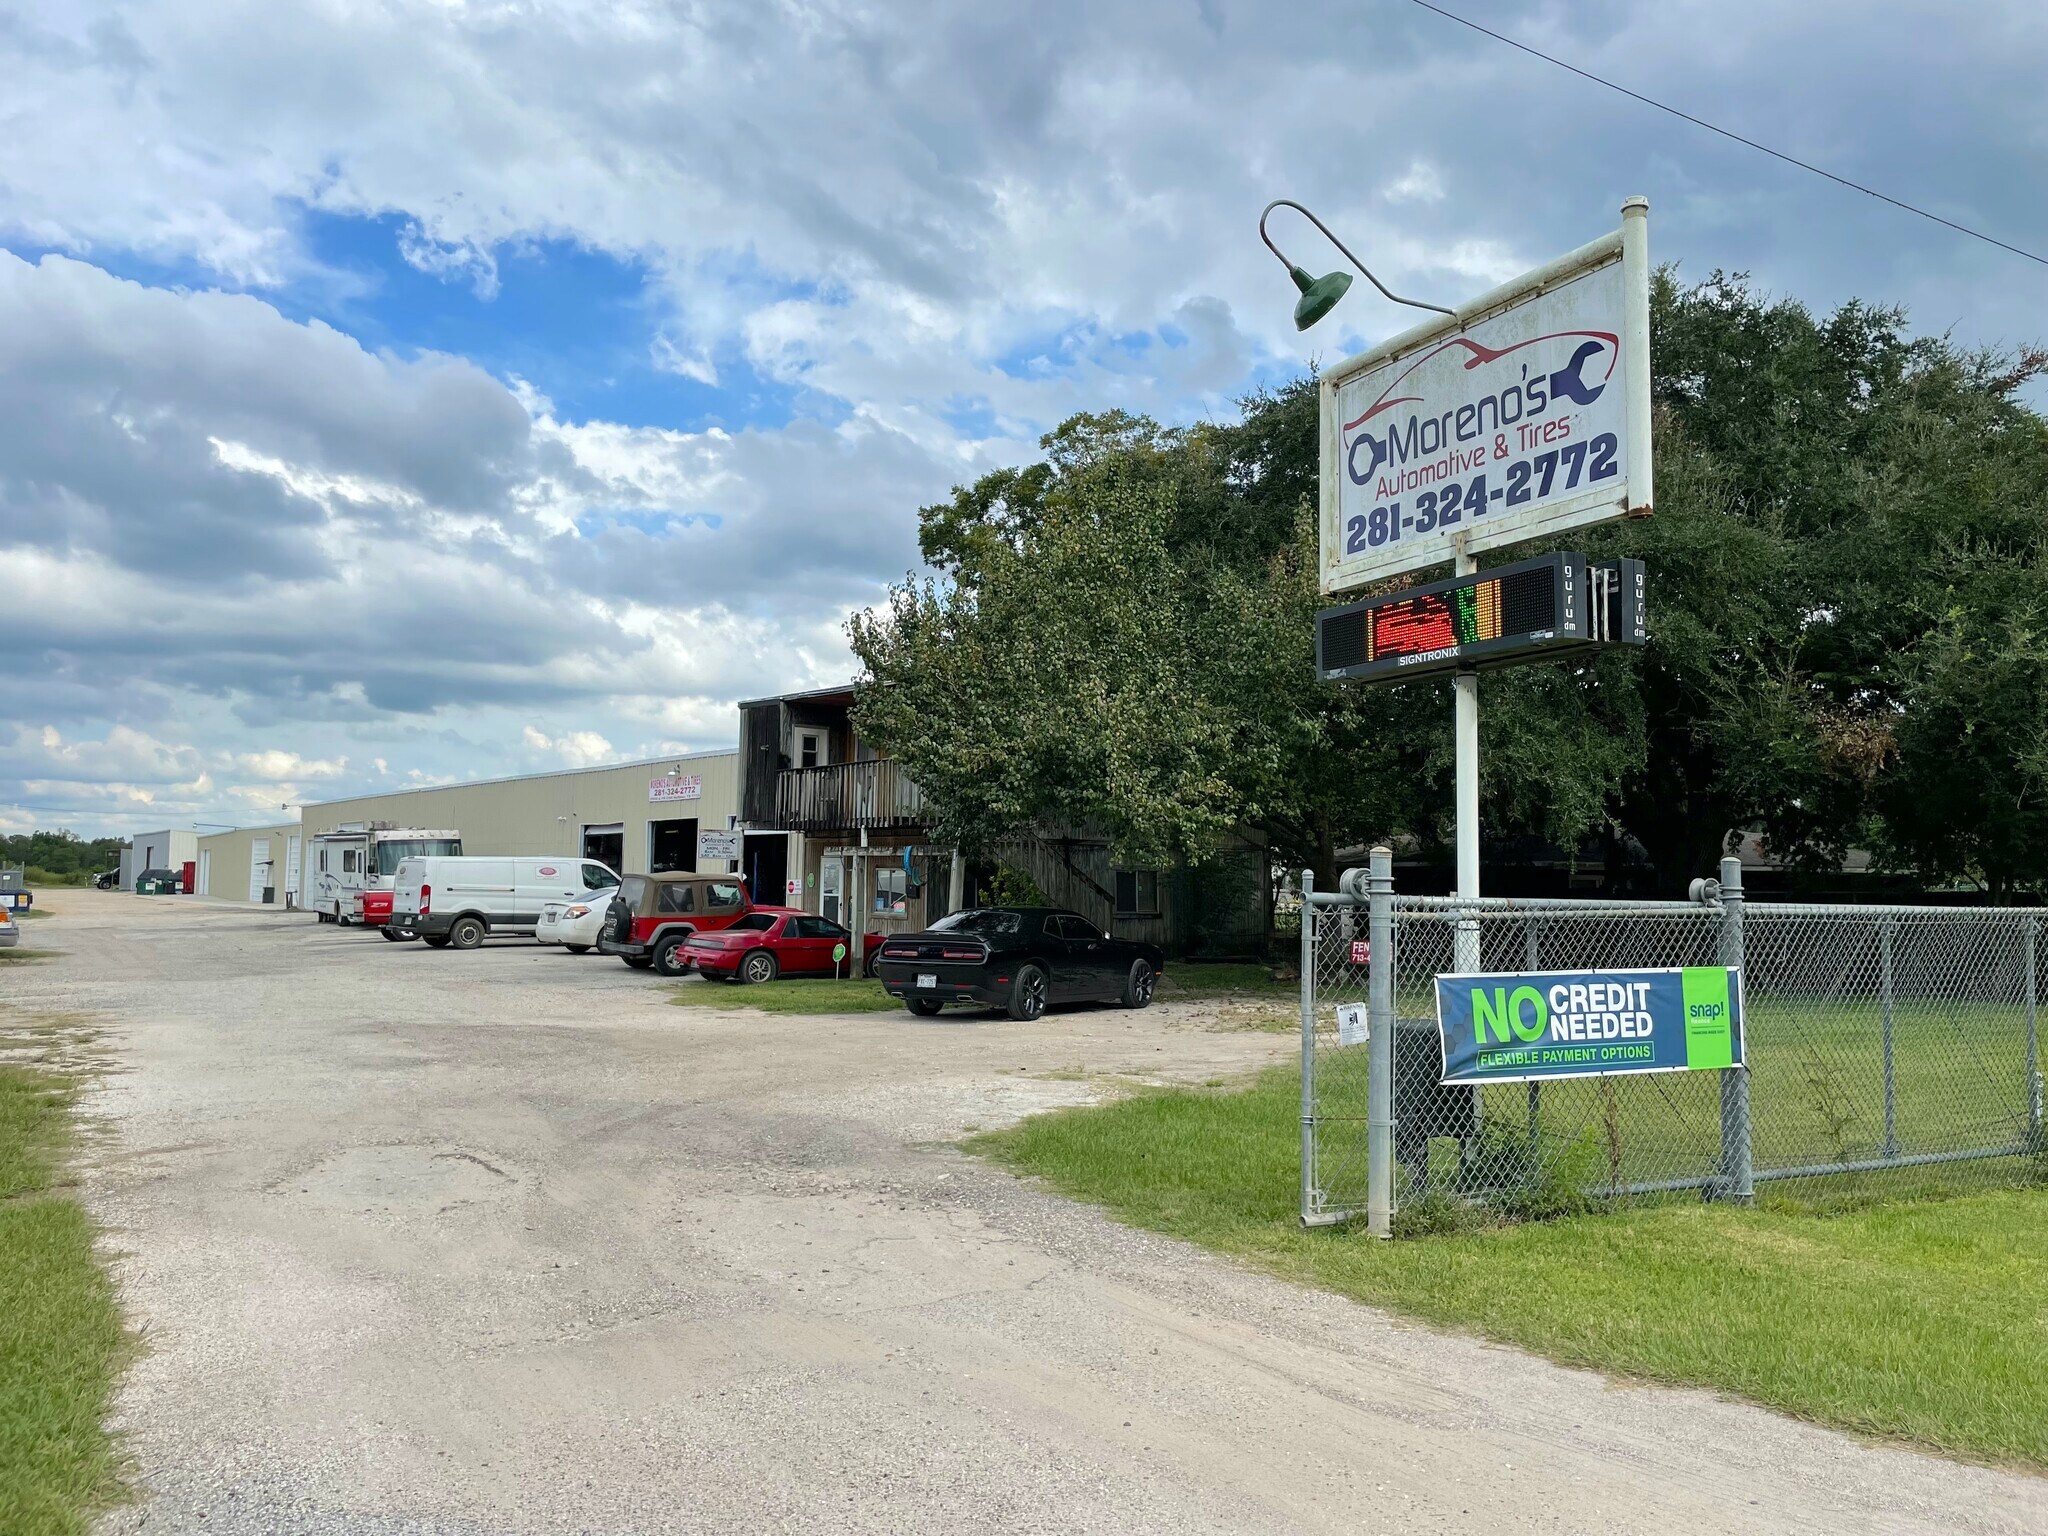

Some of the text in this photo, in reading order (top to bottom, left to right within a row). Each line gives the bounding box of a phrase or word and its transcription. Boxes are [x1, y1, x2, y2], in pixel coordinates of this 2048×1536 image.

[1389, 363, 1547, 468] Moreno's
[1376, 415, 1570, 501] Automotive & Tires
[1347, 432, 1618, 555] 281-324-2772
[1399, 646, 1459, 667] SIGNTRONIX
[654, 786, 696, 796] 281-324-2772
[1471, 982, 1651, 1044] NO CREDIT
[1550, 1011, 1653, 1041] NEEDED
[1690, 1001, 1724, 1021] snap!
[1480, 1045, 1651, 1067] FLEXIBLE PAYMENT OPTIONS
